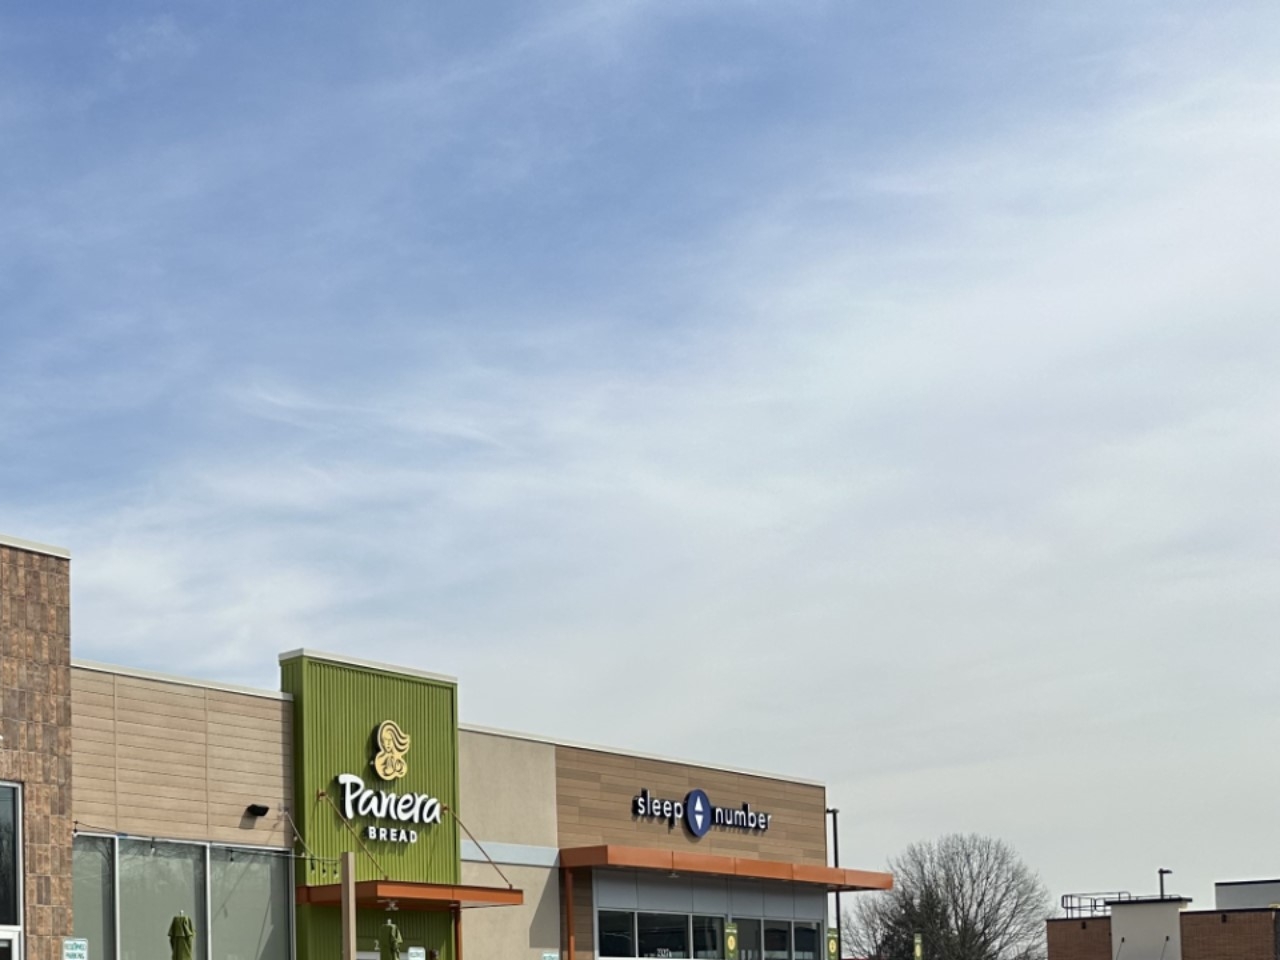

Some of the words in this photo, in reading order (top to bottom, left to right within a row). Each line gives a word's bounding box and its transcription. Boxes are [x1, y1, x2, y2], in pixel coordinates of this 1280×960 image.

[338, 773, 441, 824] Panera
[637, 789, 684, 827] sleep
[715, 803, 772, 829] number
[368, 826, 418, 843] BREAD
